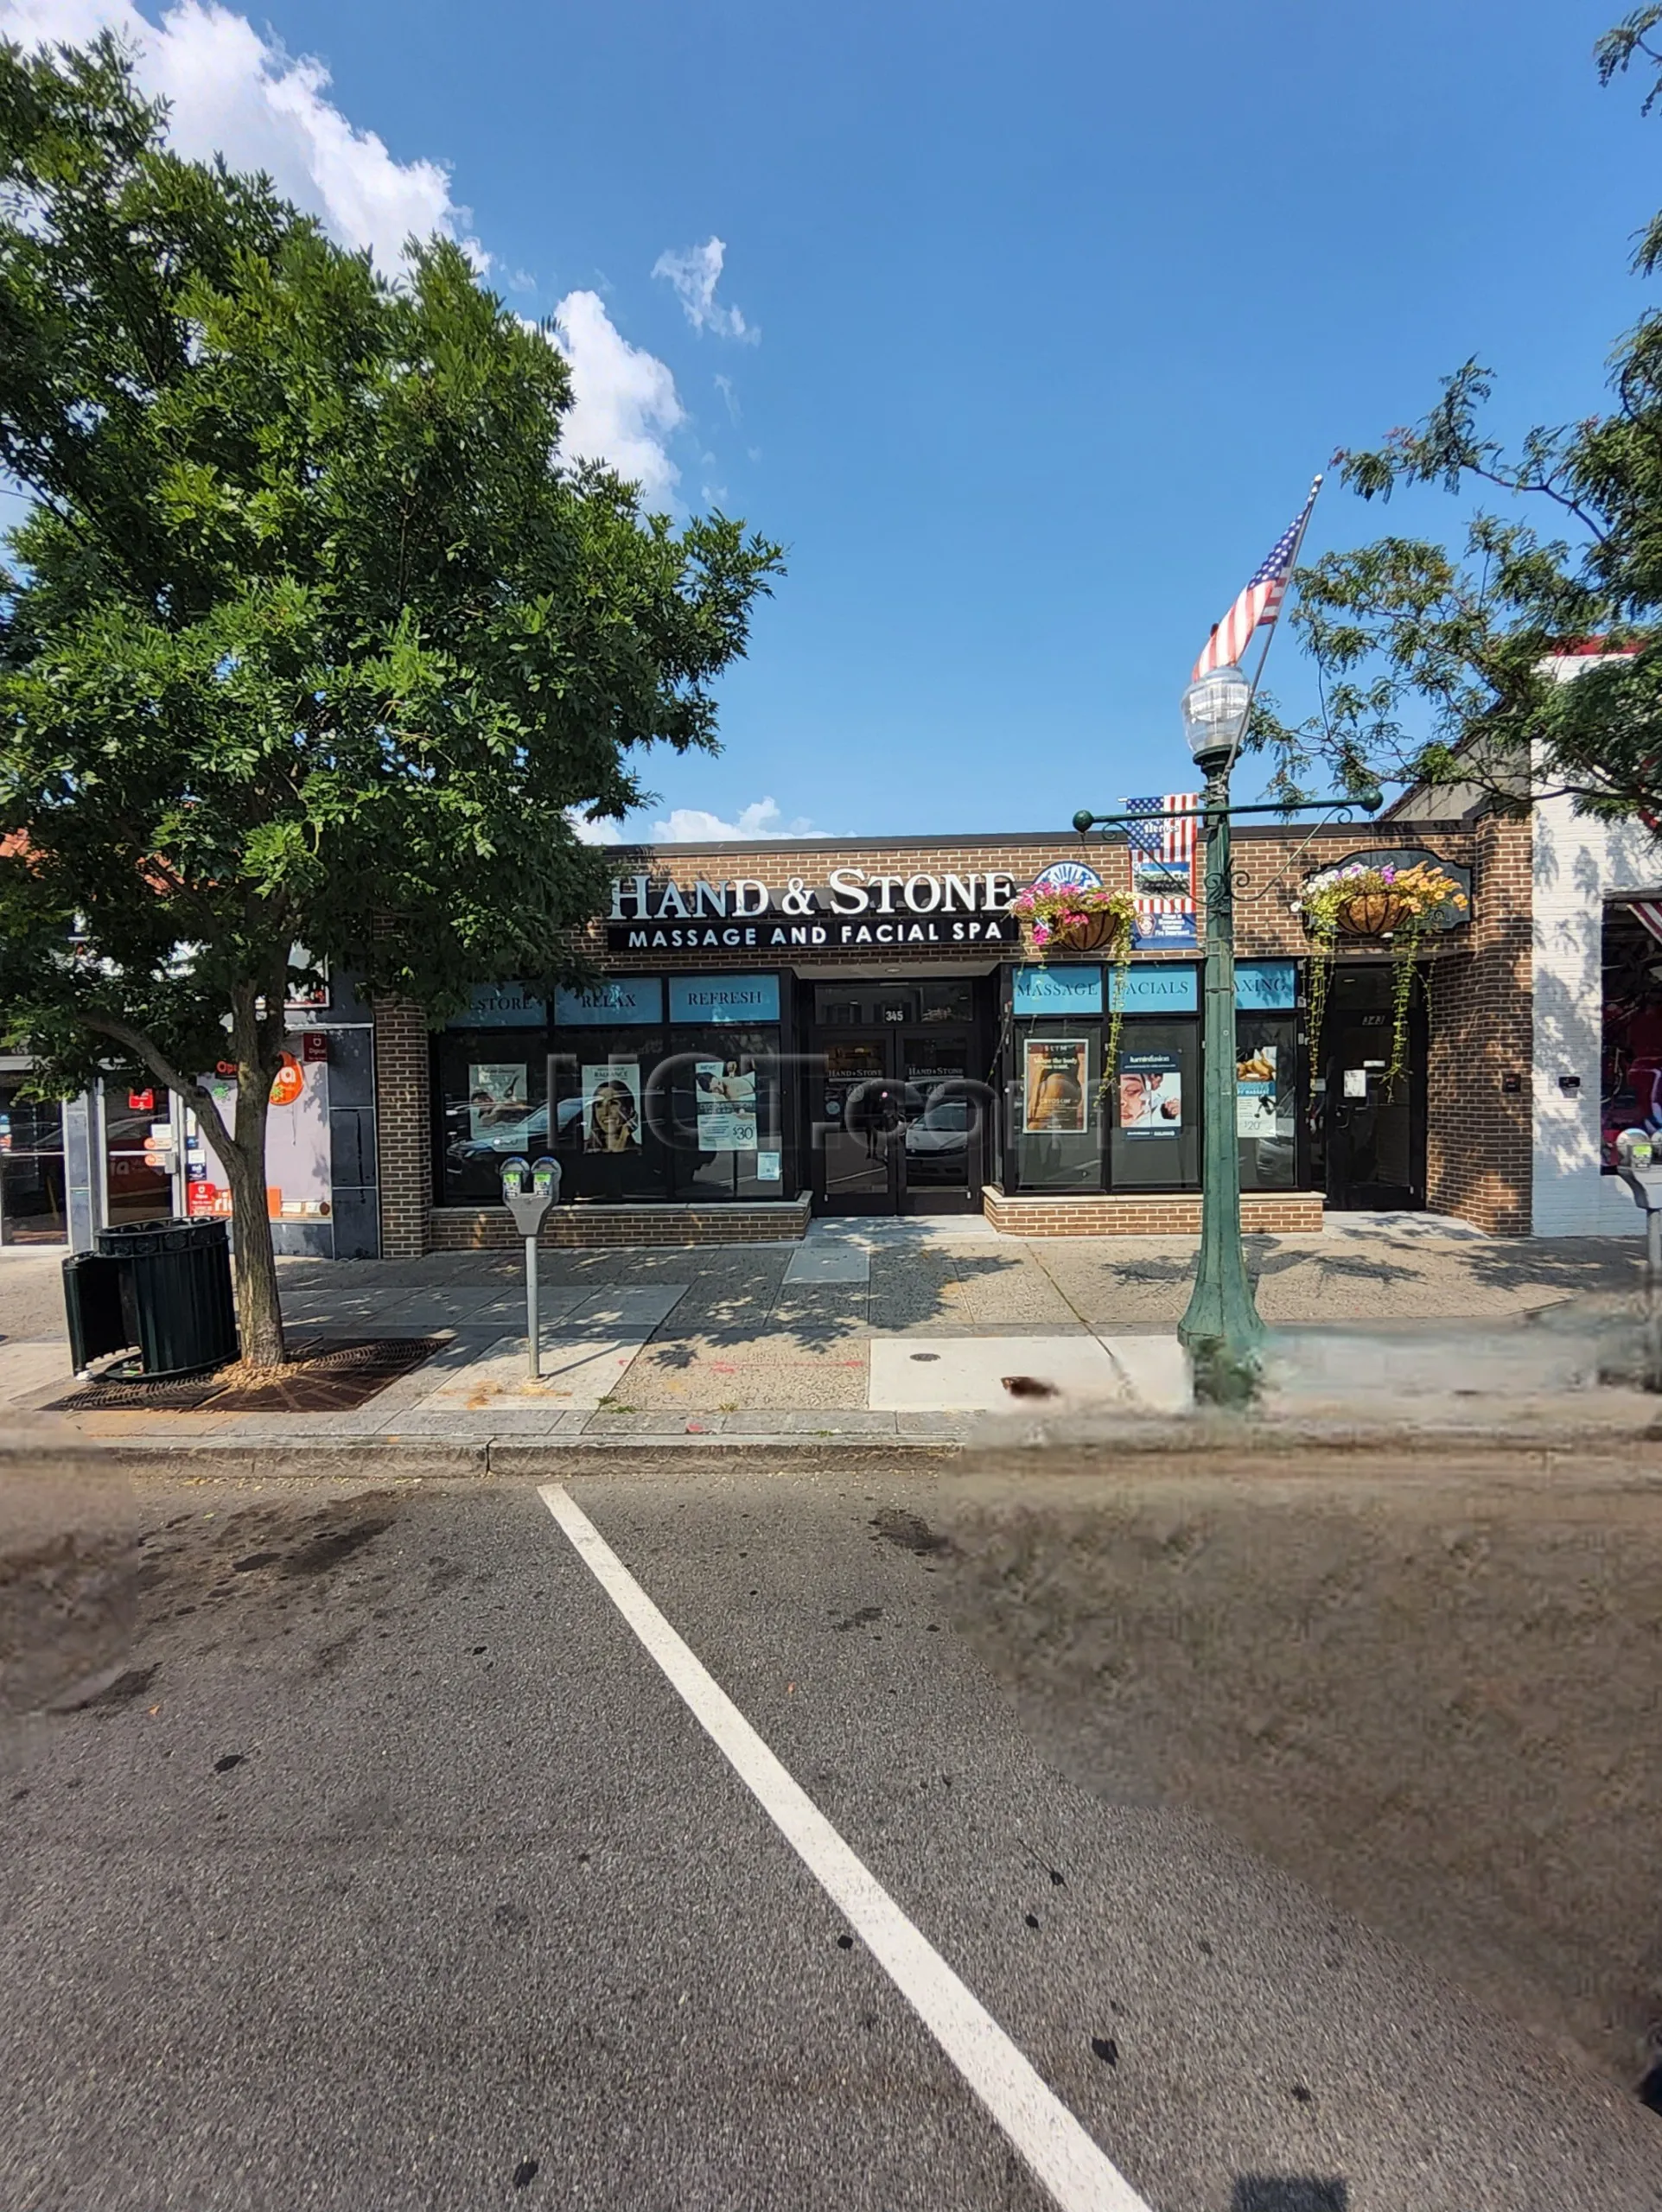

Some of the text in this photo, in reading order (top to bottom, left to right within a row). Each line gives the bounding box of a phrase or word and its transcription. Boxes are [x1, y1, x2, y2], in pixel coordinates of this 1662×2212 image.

[606, 874, 769, 920] HAND
[781, 877, 815, 916] &
[829, 868, 1016, 915] STONE
[628, 921, 1002, 948] MASSAGE AND FACIAL SPA
[1016, 982, 1098, 997] MASSAGE
[470, 996, 533, 1011] STORE
[581, 993, 636, 1008] RELAX
[688, 991, 761, 1006] REFRESH
[885, 1010, 904, 1021] 345
